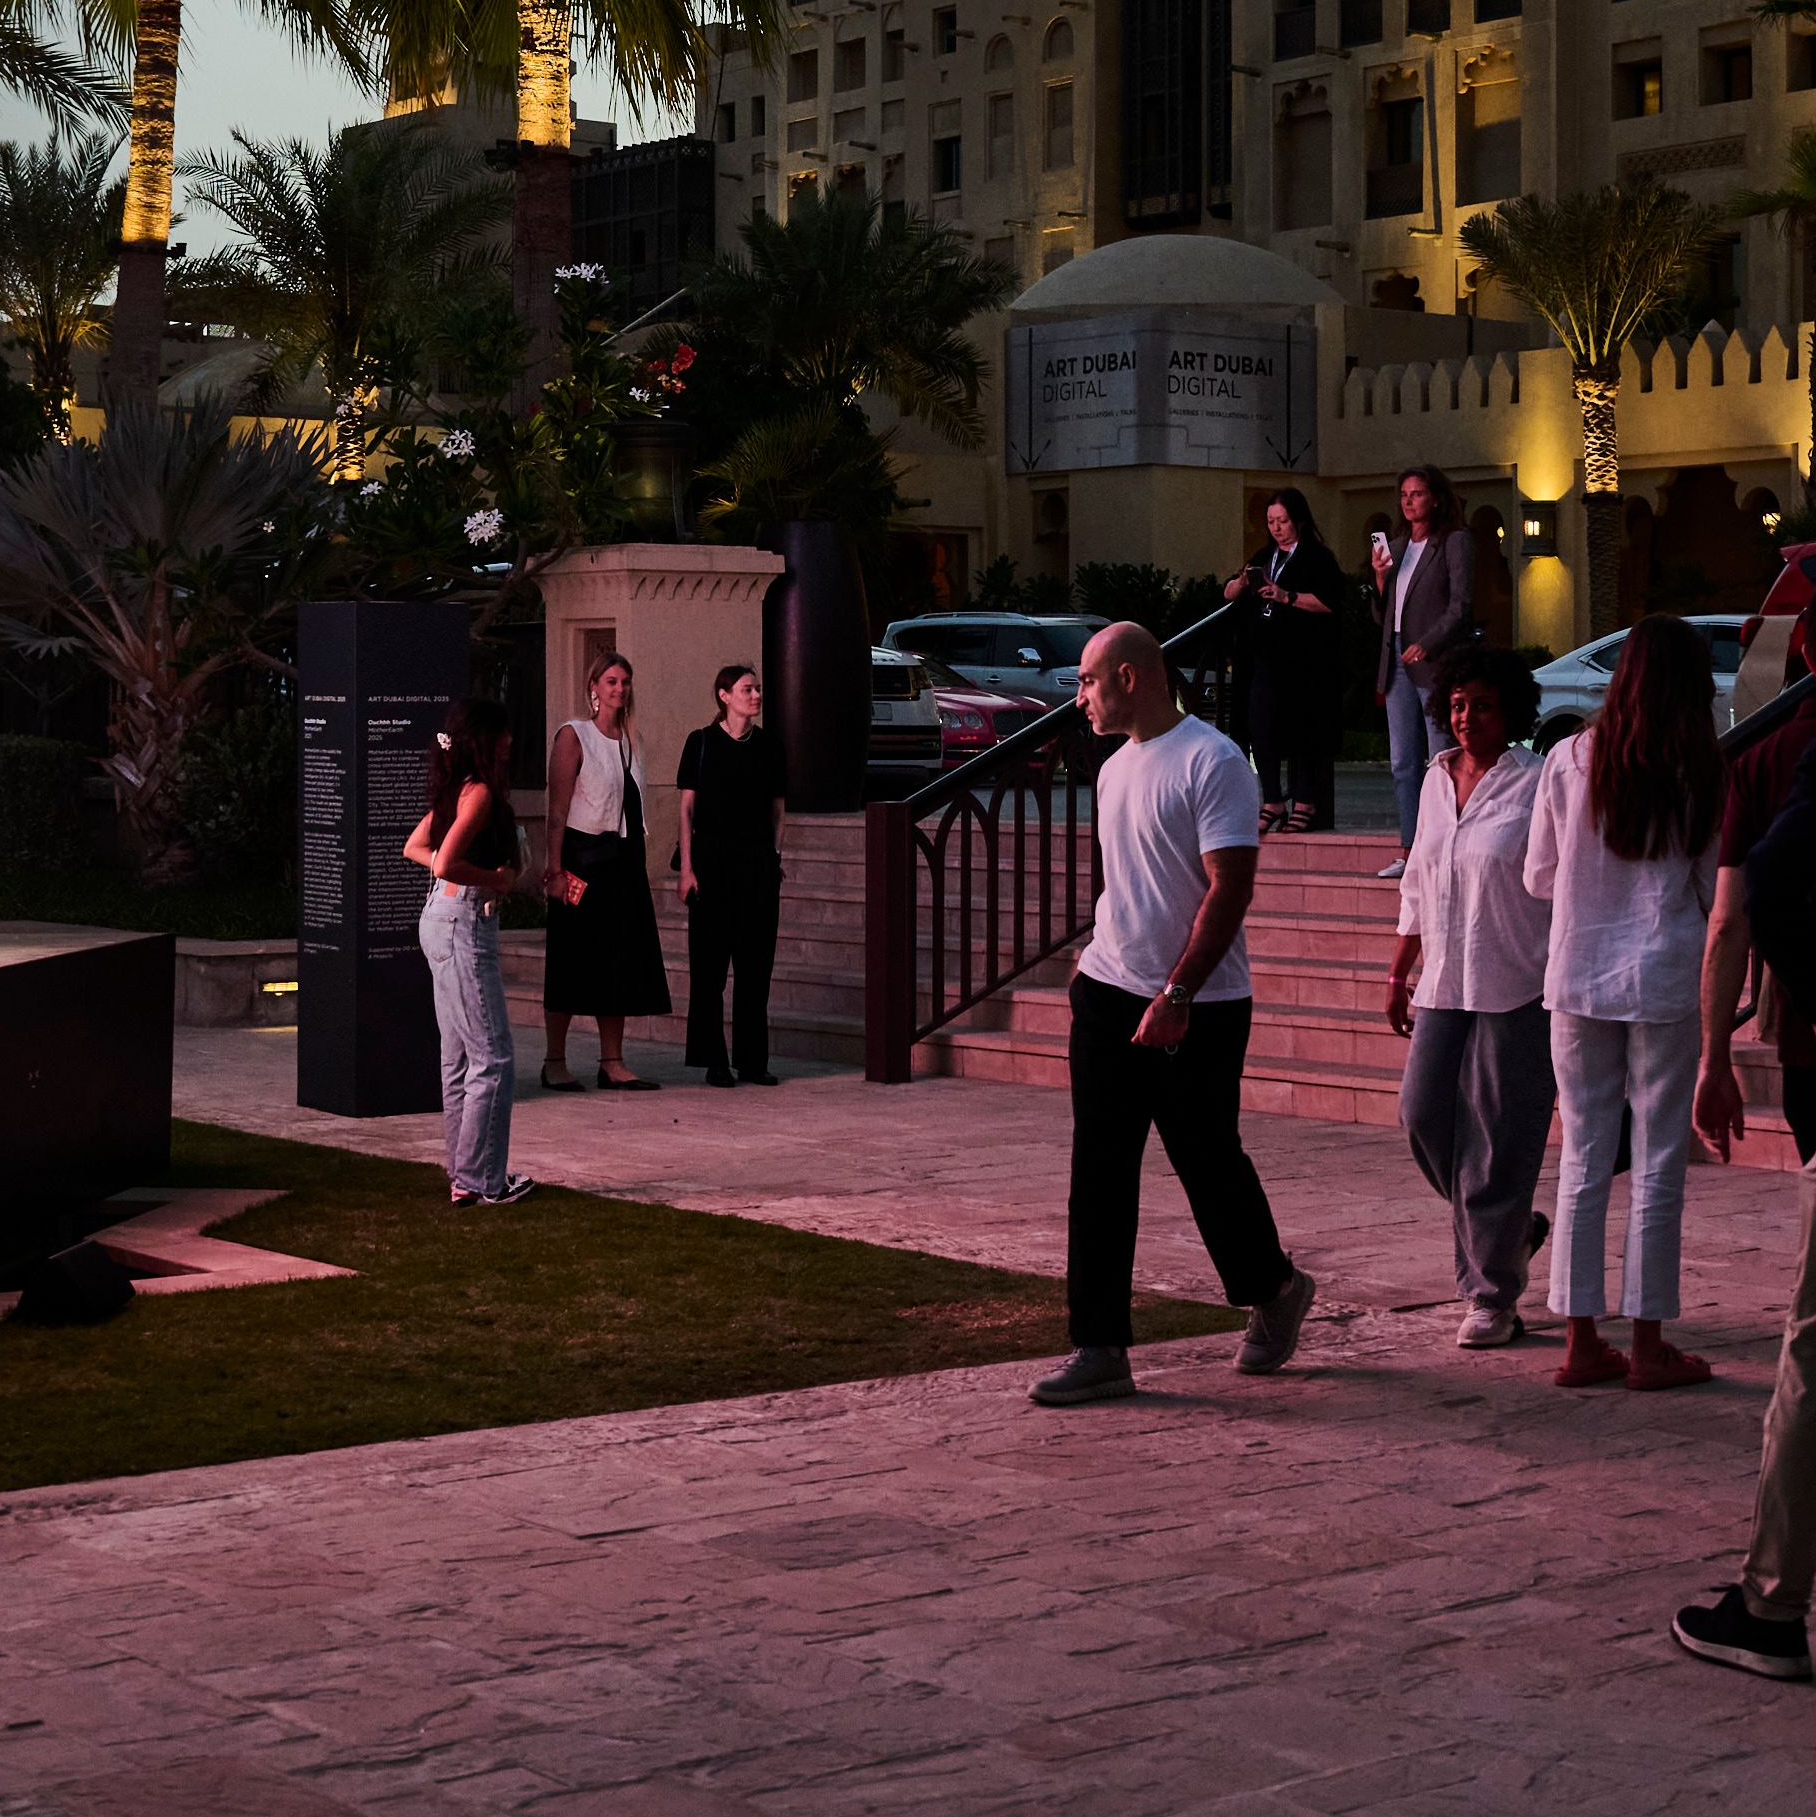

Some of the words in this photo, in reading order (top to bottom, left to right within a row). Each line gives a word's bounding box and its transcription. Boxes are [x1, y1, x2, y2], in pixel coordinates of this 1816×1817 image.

[1044, 357, 1078, 378] ART
[1083, 350, 1136, 375] DUBAI
[1168, 350, 1208, 372] ART
[1214, 354, 1273, 377] DUBAI
[1043, 379, 1107, 403] DIGITAL
[1167, 375, 1242, 399] DIGITAL
